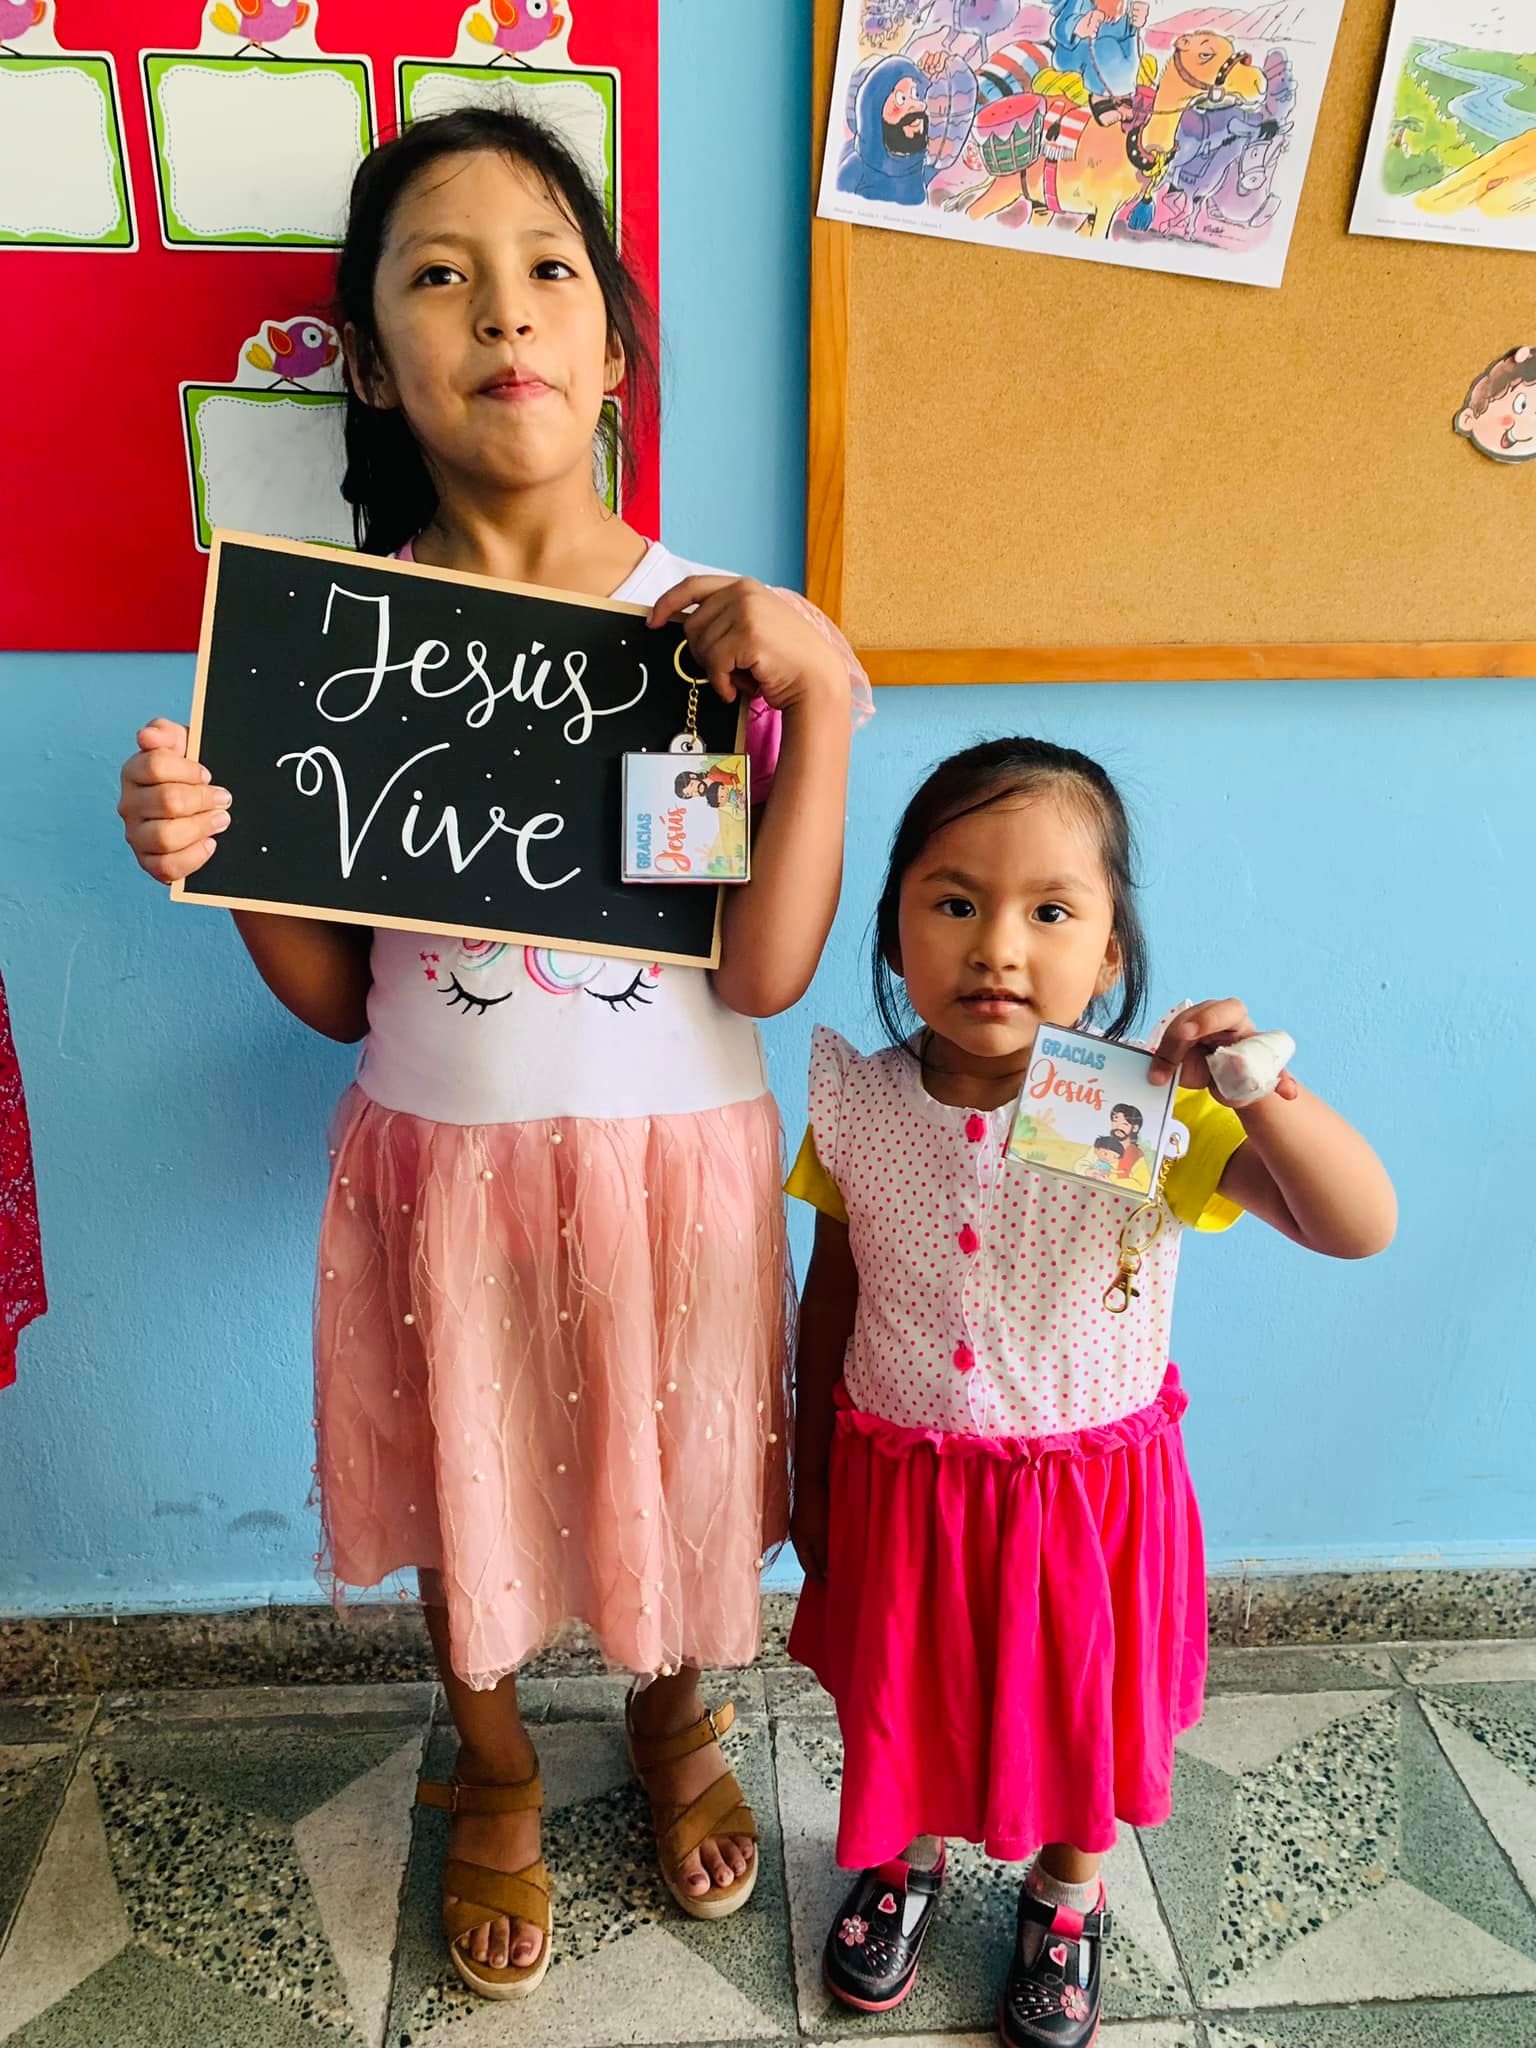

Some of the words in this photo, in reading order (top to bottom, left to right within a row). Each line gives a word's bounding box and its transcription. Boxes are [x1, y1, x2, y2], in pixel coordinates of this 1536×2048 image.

[316, 583, 648, 745] Jesús
[276, 742, 582, 890] Vive
[636, 812, 652, 870] GRACIAS
[654, 803, 692, 874] Jesús
[1029, 1058, 1105, 1111] Jesús
[1041, 1037, 1106, 1071] GRACIAS
